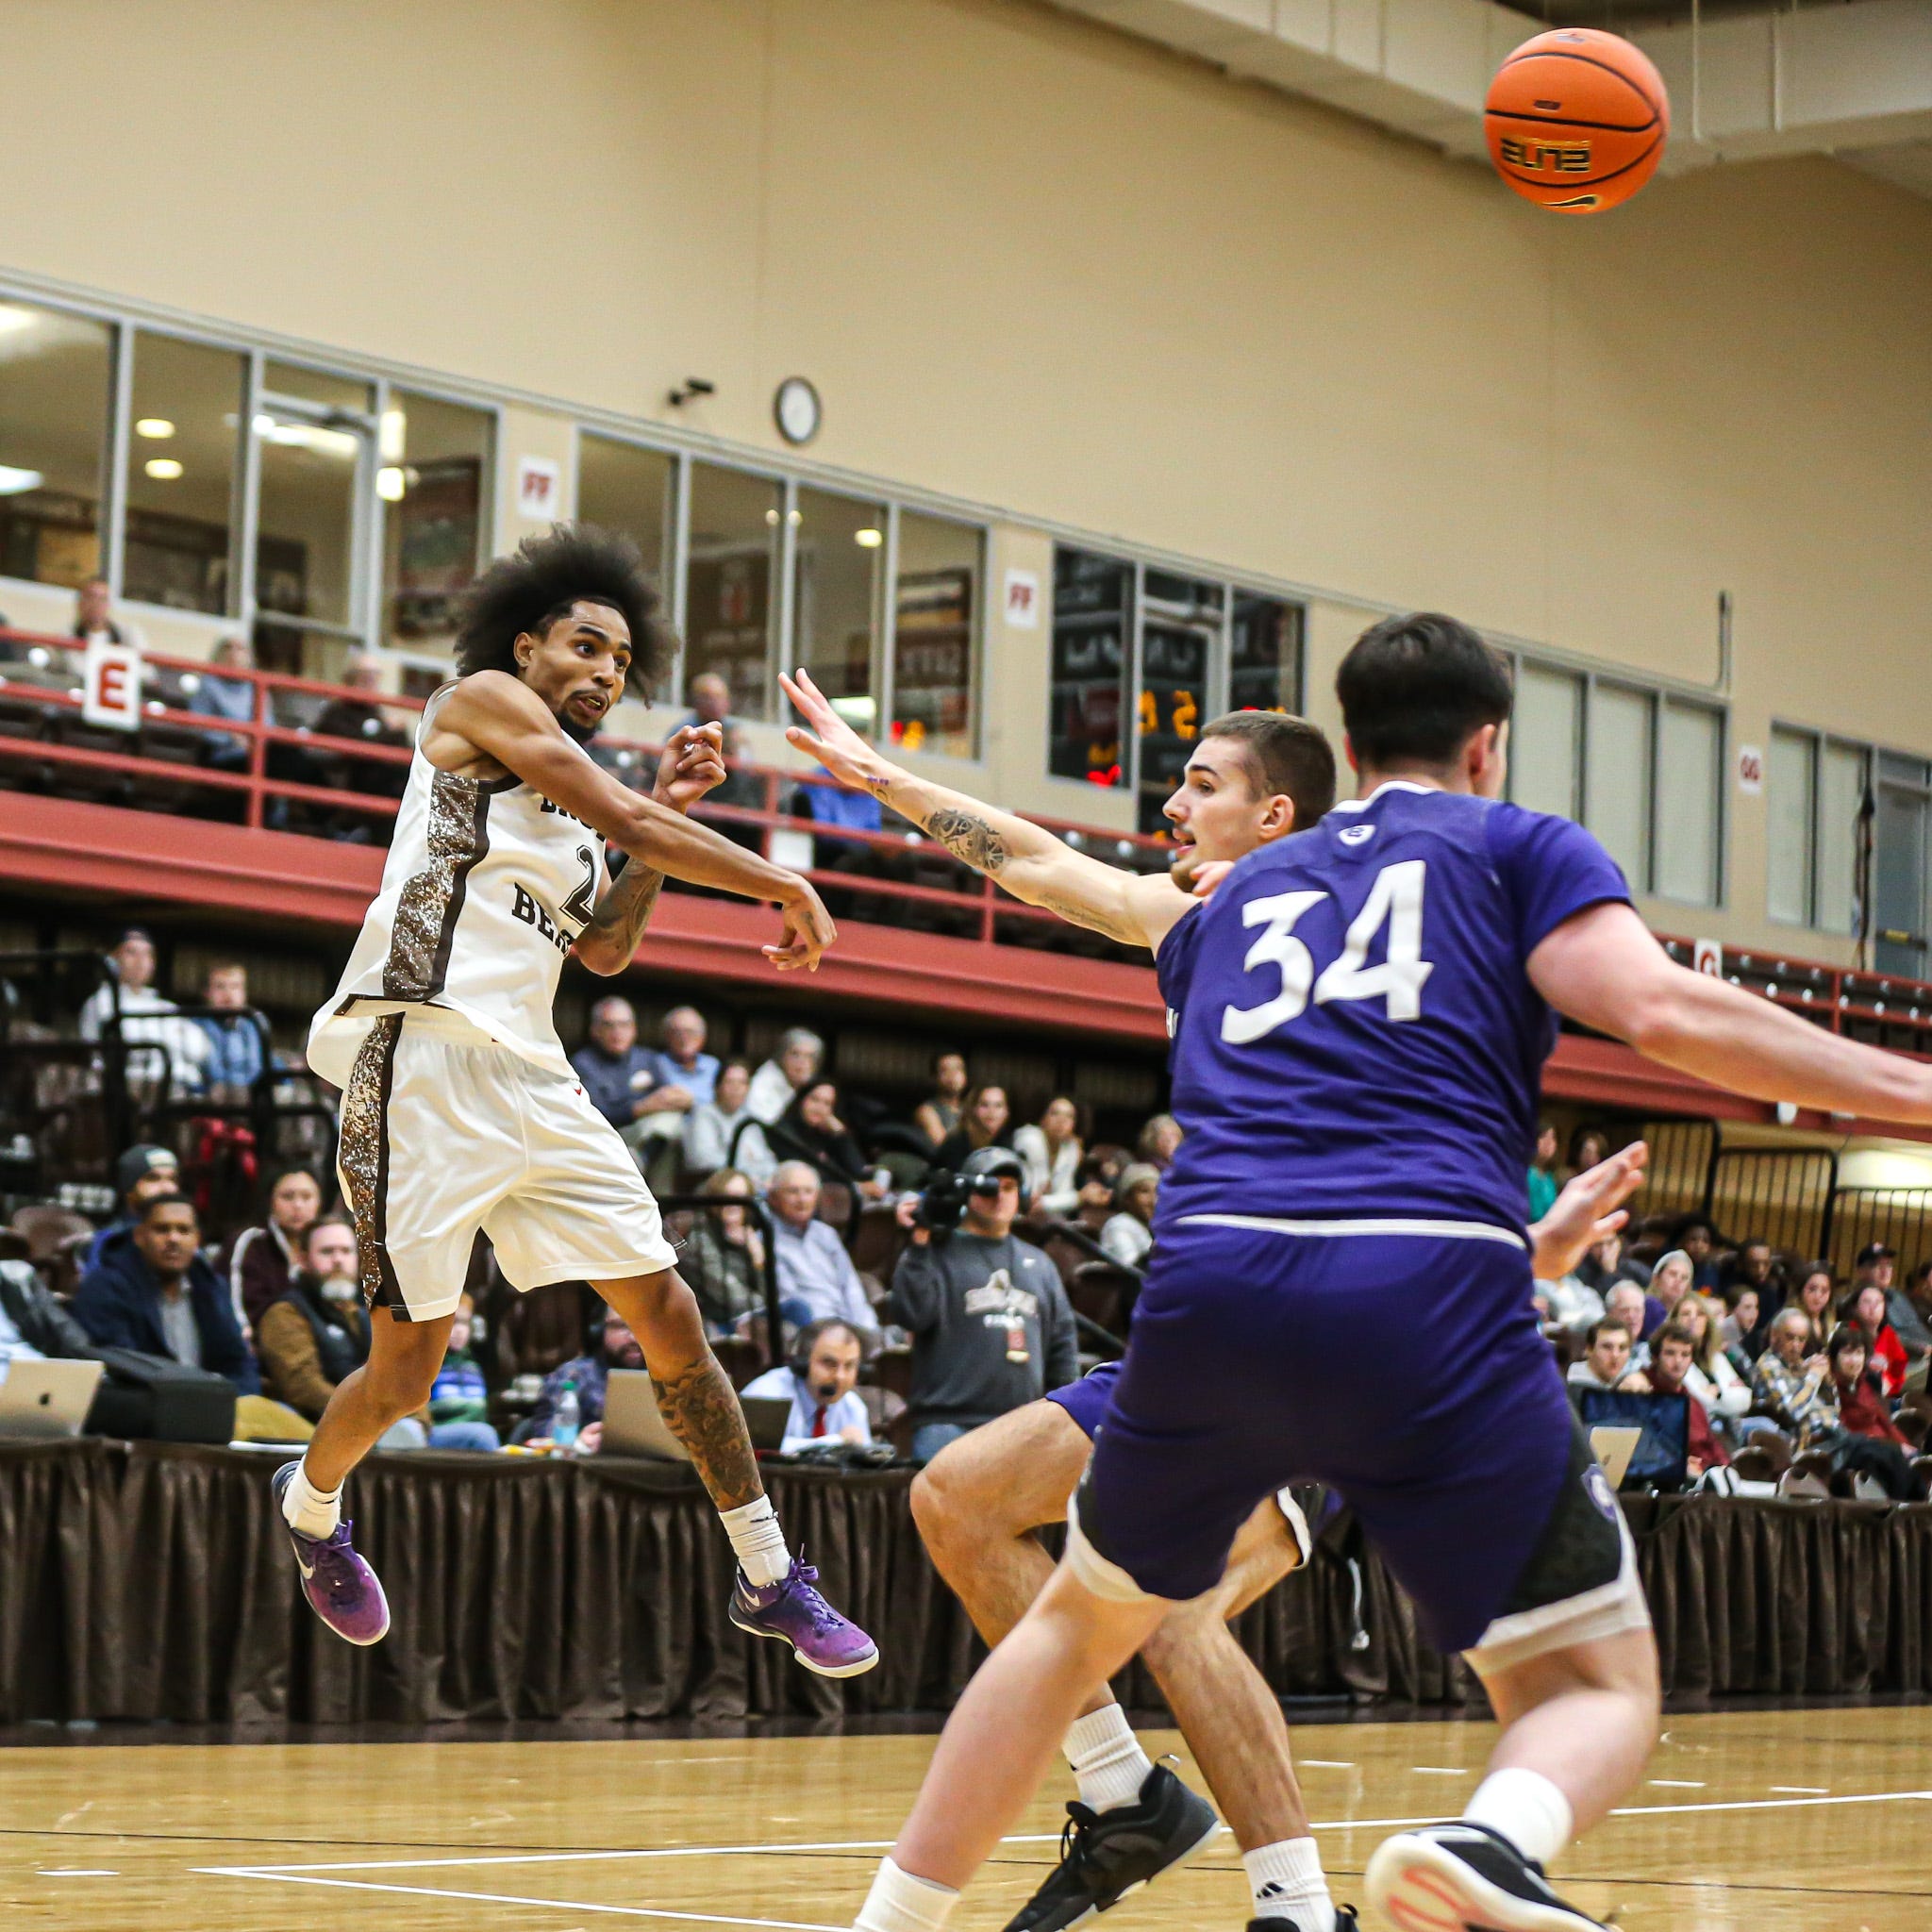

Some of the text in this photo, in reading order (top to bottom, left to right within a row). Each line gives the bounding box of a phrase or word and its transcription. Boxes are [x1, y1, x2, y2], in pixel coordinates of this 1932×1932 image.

[99, 661, 127, 710] E
[558, 844, 595, 927] 2
[1221, 859, 1435, 1044] 34
